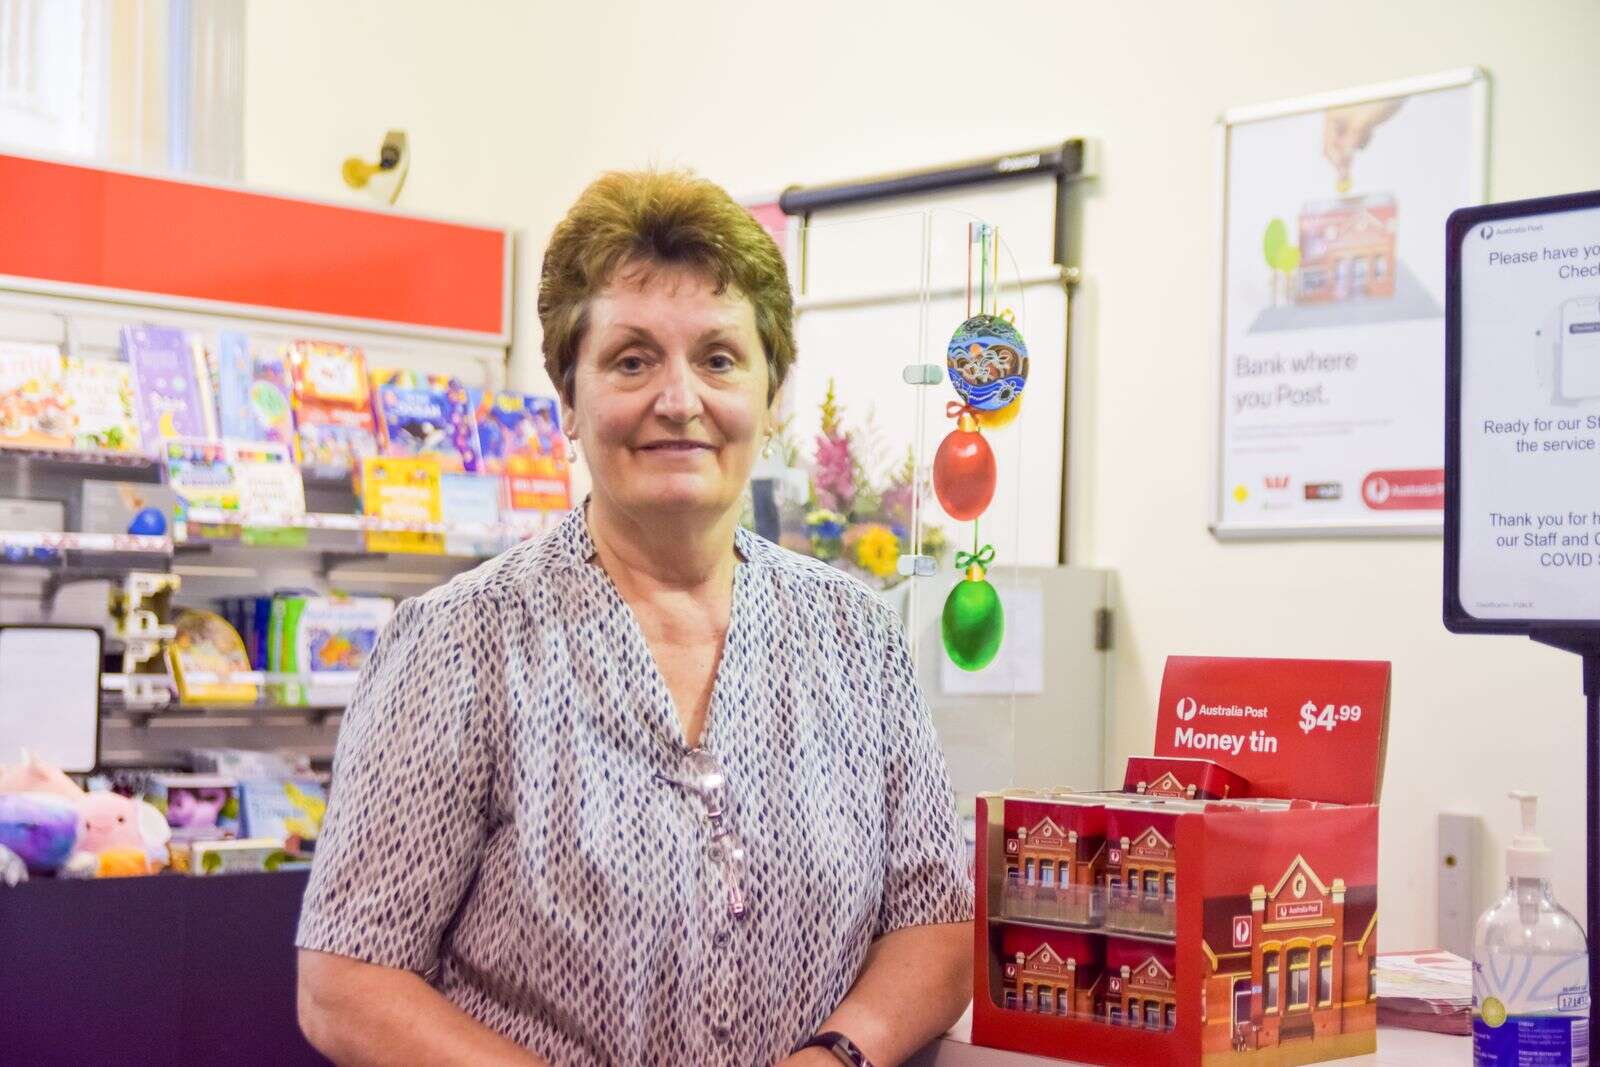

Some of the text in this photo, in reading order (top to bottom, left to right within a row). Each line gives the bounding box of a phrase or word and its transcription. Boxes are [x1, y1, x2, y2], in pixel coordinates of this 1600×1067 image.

[1489, 250, 1538, 265] Please
[1543, 247, 1578, 261] have
[1235, 350, 1358, 377] Bank where
[1234, 383, 1330, 413] you Post.
[1484, 420, 1530, 435] Ready
[1534, 418, 1553, 431] for
[1557, 419, 1581, 430] our
[1516, 436, 1595, 453] the service
[1489, 512, 1532, 527] Thank
[1538, 515, 1563, 529] you
[1568, 511, 1588, 525] for
[1496, 535, 1520, 547] our
[1524, 532, 1557, 546] Staff
[1562, 532, 1588, 546] and
[1540, 552, 1592, 567] COVID
[1199, 704, 1268, 719] Australia Post
[1299, 700, 1361, 734] $4.99
[1174, 727, 1278, 756] Money tin
